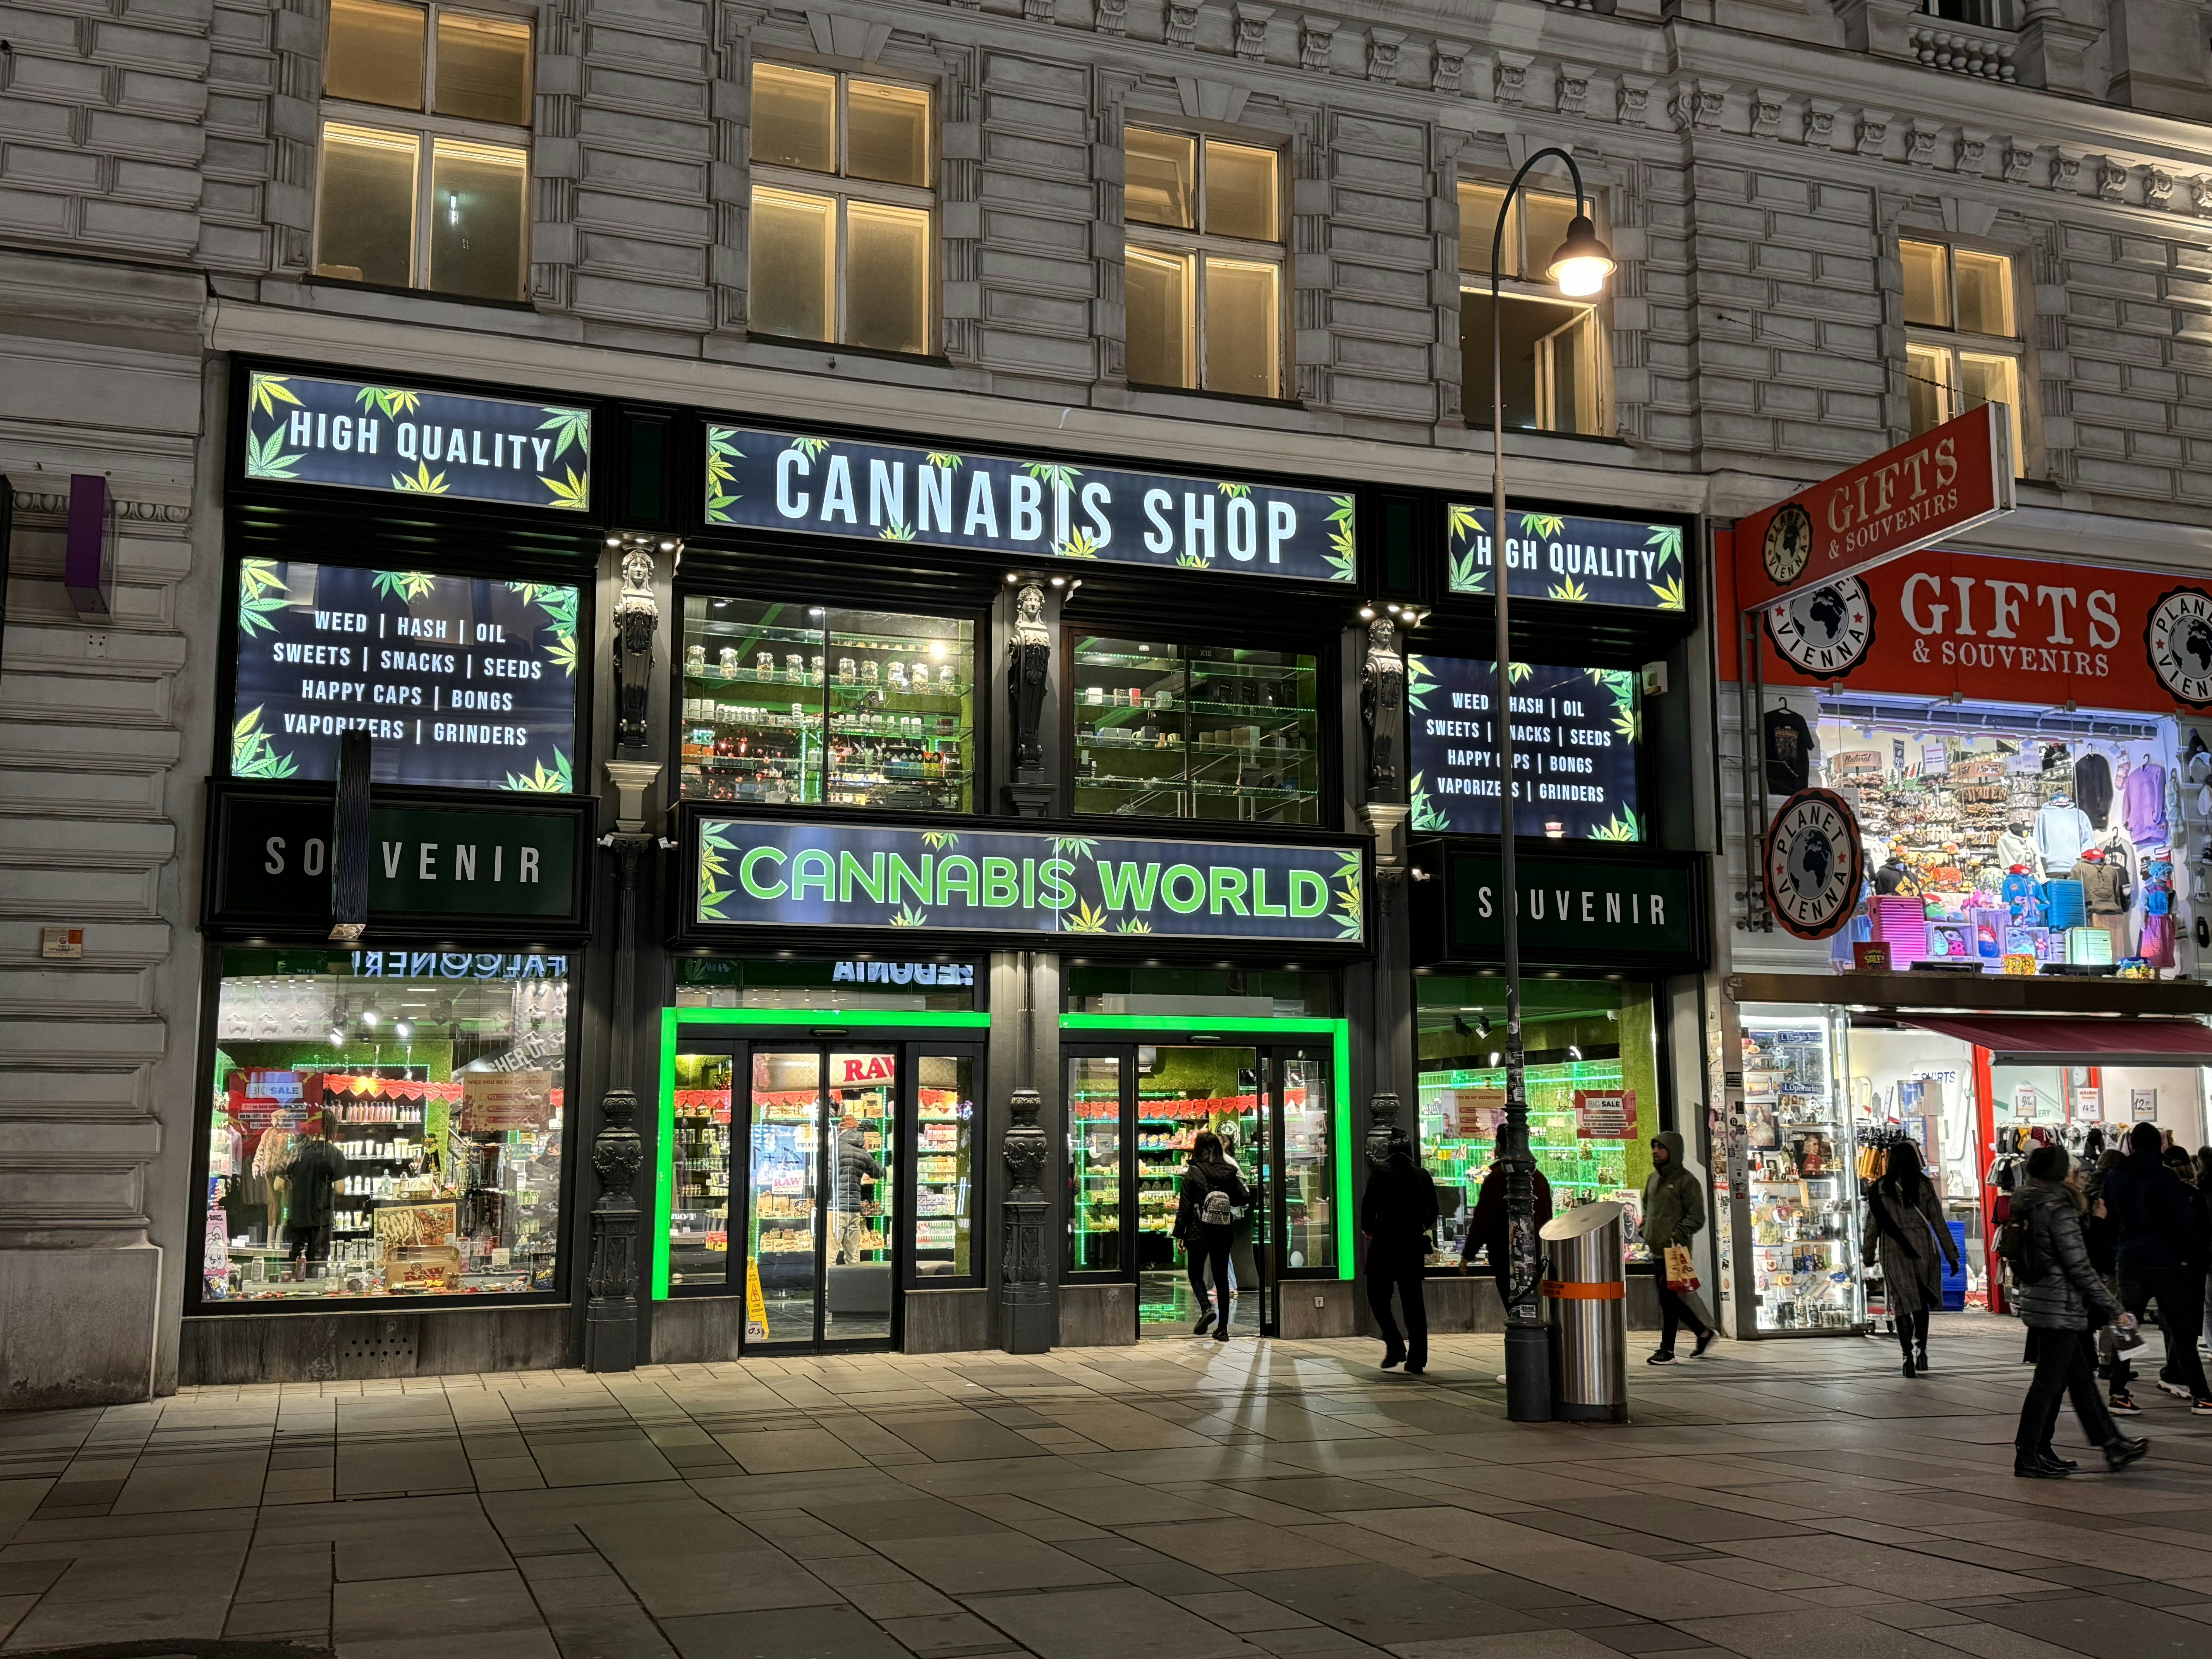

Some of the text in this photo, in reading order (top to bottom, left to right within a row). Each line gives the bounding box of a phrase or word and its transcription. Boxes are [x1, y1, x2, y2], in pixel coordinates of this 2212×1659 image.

[289, 410, 550, 471] HIGH QUALITY
[1828, 437, 1958, 534] GIFTS
[777, 449, 1297, 563] CANNABIS SHOP
[1829, 488, 1958, 560] & SOUVENIRS
[1477, 535, 1656, 580] HGH QUALITY
[1769, 545, 1807, 579] VIENNA
[315, 611, 505, 642] WEED HASH OIL
[1901, 573, 2121, 649] GIFTS
[2155, 598, 2212, 633] PLAN
[273, 643, 541, 679] SWEETS SNACKS SEEDS
[1778, 622, 1864, 668] VIENNA
[1913, 638, 2109, 677] & SOUVENIRS
[2159, 654, 2212, 697] VIEN
[302, 680, 512, 711] HAPPY CAPS BONGS
[1452, 692, 1585, 718] WEED HASH OIL
[285, 714, 526, 745] VAPORIZERS GRINDERS
[1426, 720, 1611, 747] SWEETS NACKS SEEDS
[1448, 749, 1593, 774] HAPPY PS BONGS
[1437, 777, 1604, 803] VAPORIZES GRINDERS
[1777, 805, 1844, 855] PLANET
[265, 836, 539, 883] SOVENIR
[740, 846, 1329, 918] CANNABIS WORLD
[1778, 871, 1847, 921] VIENNA
[1479, 886, 1665, 925] SUVENIR
[774, 1177, 802, 1187] RAW
